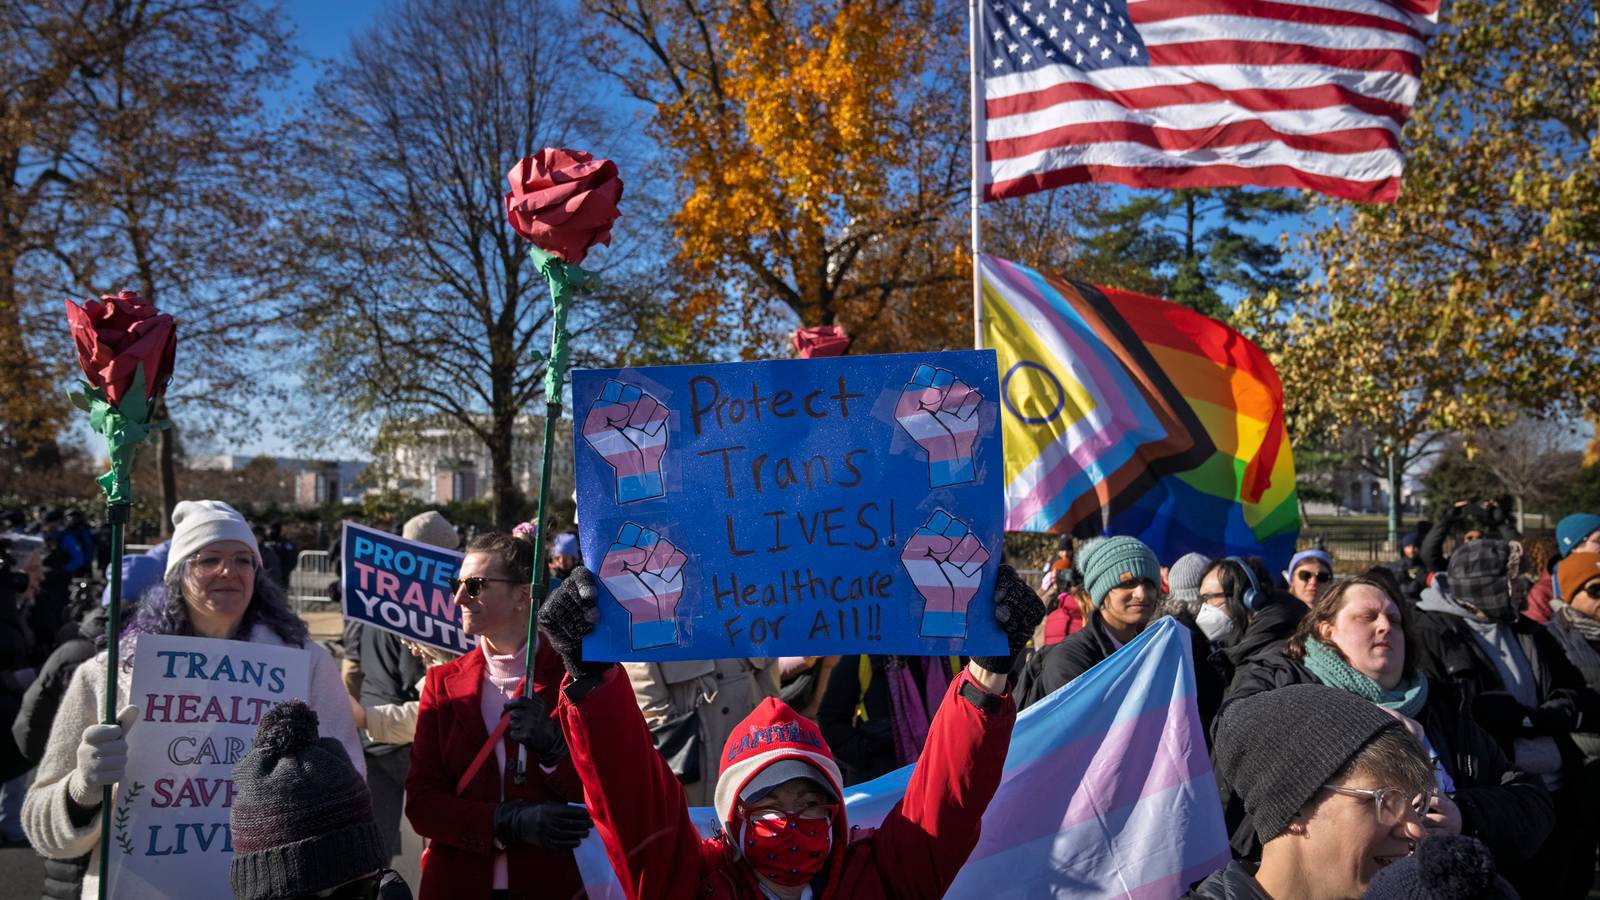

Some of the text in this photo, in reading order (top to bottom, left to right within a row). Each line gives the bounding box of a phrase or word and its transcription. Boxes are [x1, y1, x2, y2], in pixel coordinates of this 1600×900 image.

[688, 375, 866, 437] Protect
[697, 446, 868, 500] Trans
[726, 498, 896, 557] LIVES!
[354, 536, 461, 588] PROTE
[354, 561, 464, 623] TRAN
[712, 568, 894, 610] Healthcare
[355, 589, 482, 651] YOUTH
[808, 603, 881, 641] All!!
[157, 651, 286, 694] TRANS
[143, 694, 272, 726] HEALT
[168, 737, 246, 766] CAR
[145, 823, 235, 856] LIV
